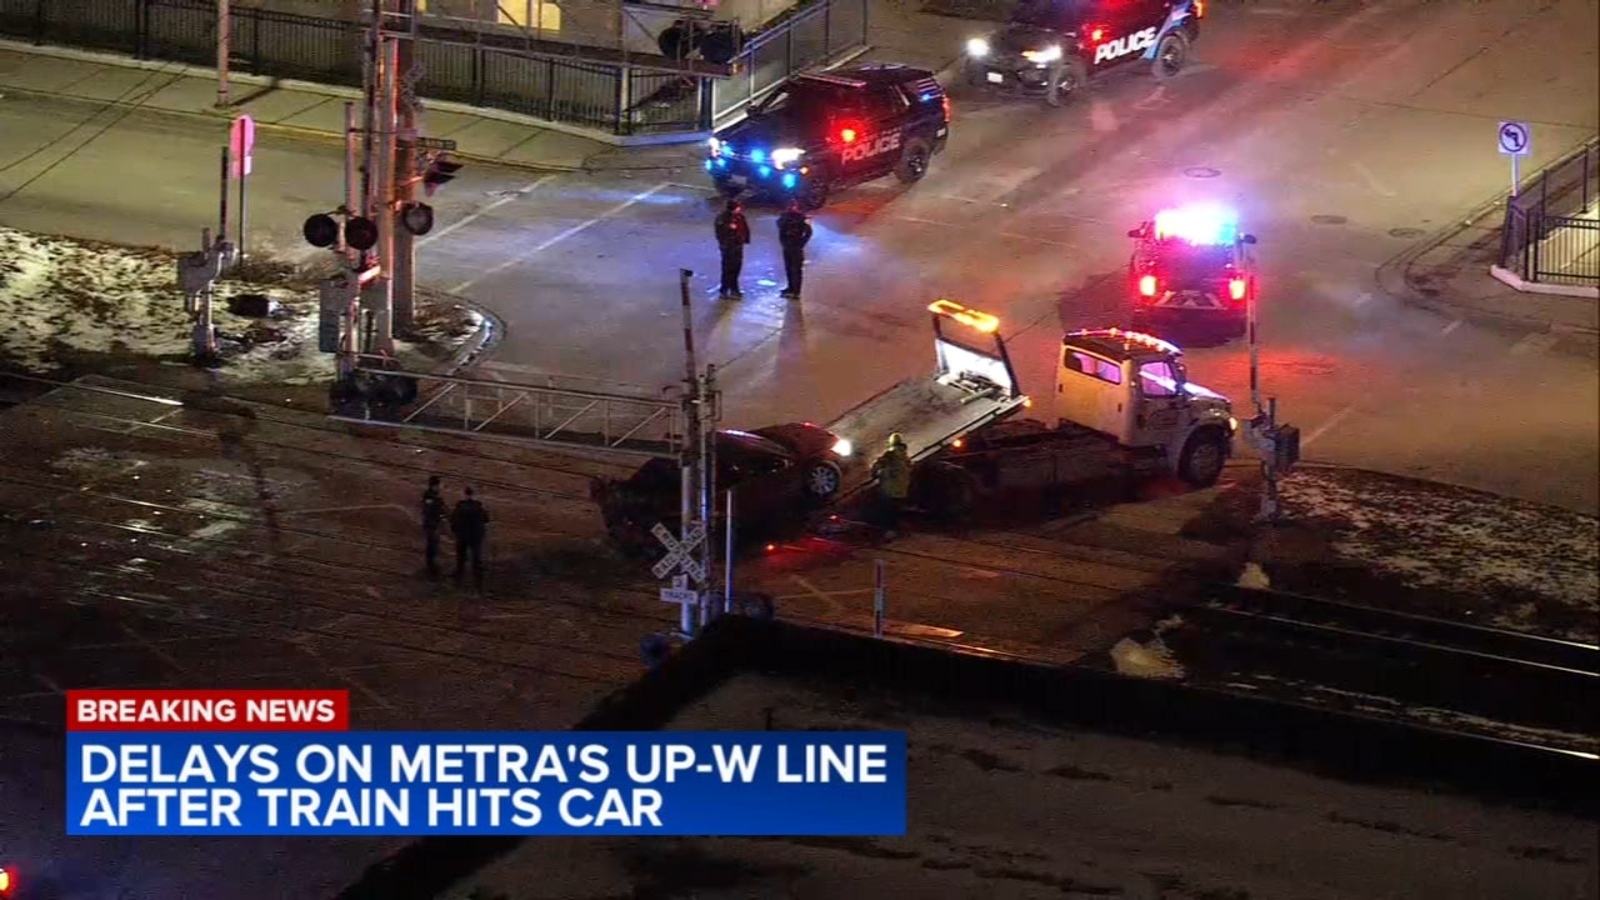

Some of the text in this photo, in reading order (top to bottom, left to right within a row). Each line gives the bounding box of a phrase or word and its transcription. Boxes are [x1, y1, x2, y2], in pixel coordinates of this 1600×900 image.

[1094, 26, 1157, 64] POLICE
[841, 132, 902, 165] POLICE
[664, 590, 695, 601] TRACKS
